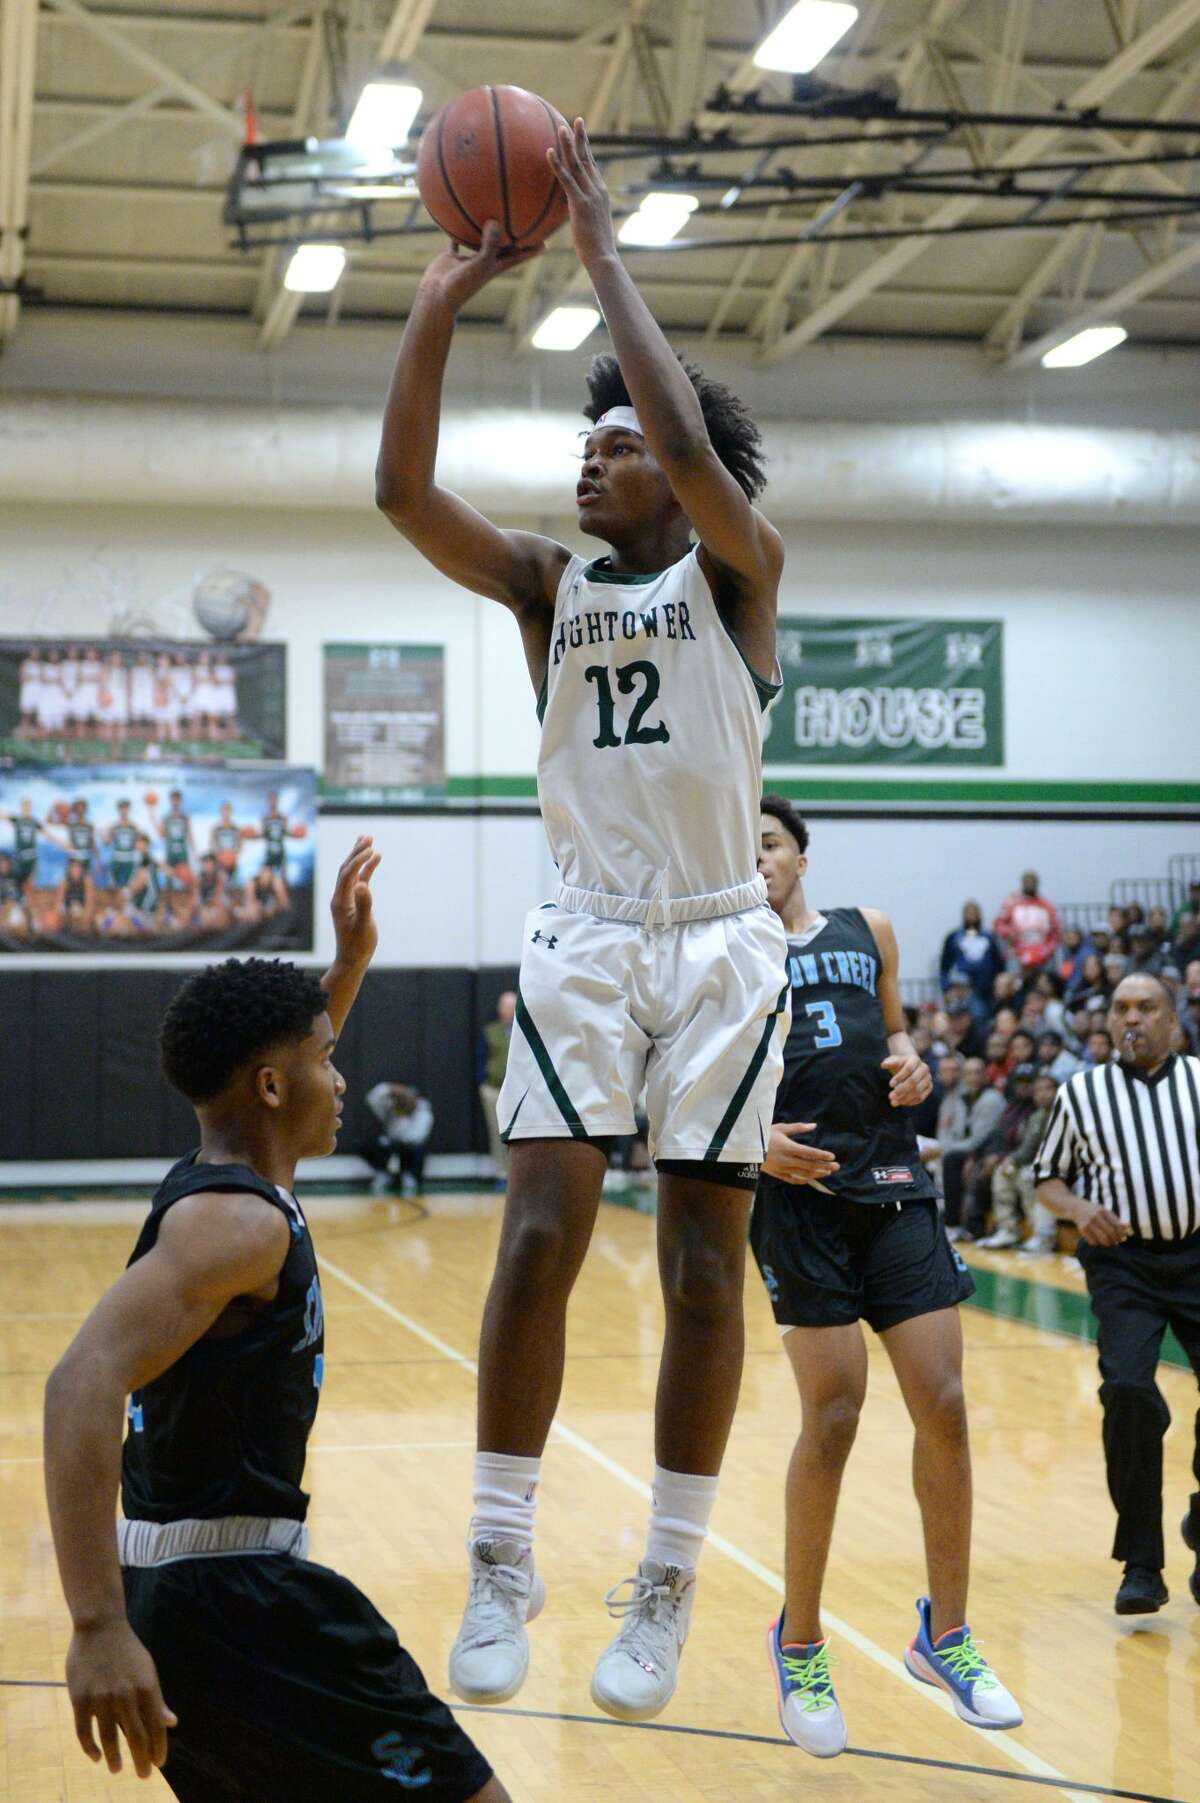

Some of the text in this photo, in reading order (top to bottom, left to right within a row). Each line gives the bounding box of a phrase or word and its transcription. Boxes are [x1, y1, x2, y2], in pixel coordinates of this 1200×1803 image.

[553, 601, 697, 665] HGHTOWER
[584, 660, 671, 749] 12
[795, 686, 987, 749] HOUSE
[789, 953, 820, 988] OW
[804, 1000, 843, 1049] 3
